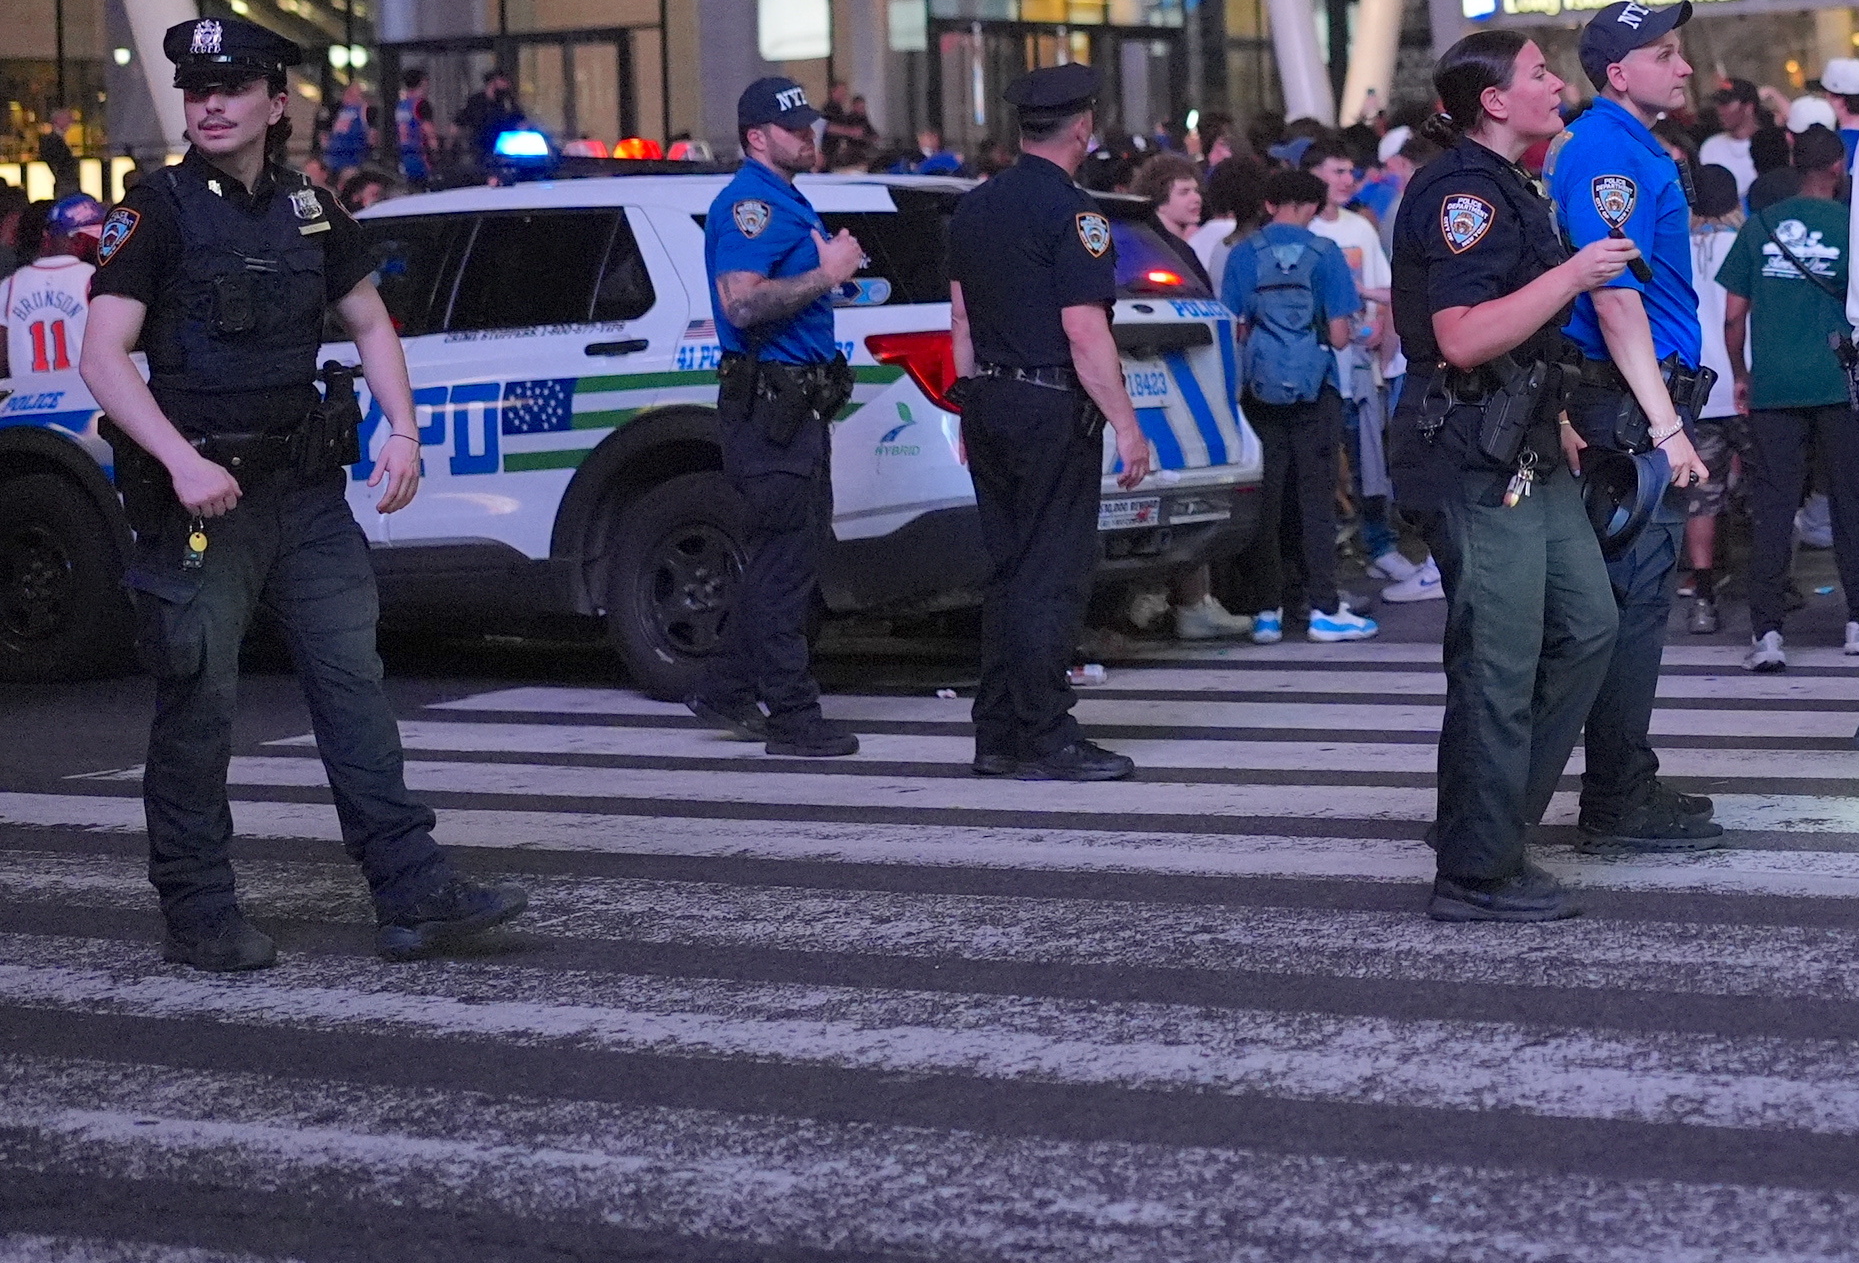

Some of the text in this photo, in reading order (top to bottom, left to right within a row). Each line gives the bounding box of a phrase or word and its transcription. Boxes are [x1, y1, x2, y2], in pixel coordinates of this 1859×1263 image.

[1617, 2, 1650, 30] NY
[1446, 203, 1488, 219] DEPARTMENT
[1457, 197, 1482, 209] POLICE
[13, 290, 84, 322] BRUNSON
[30, 319, 70, 372] 11
[677, 346, 722, 370] 41 PC
[5, 391, 66, 411] POLICE
[350, 382, 501, 481] YPD
